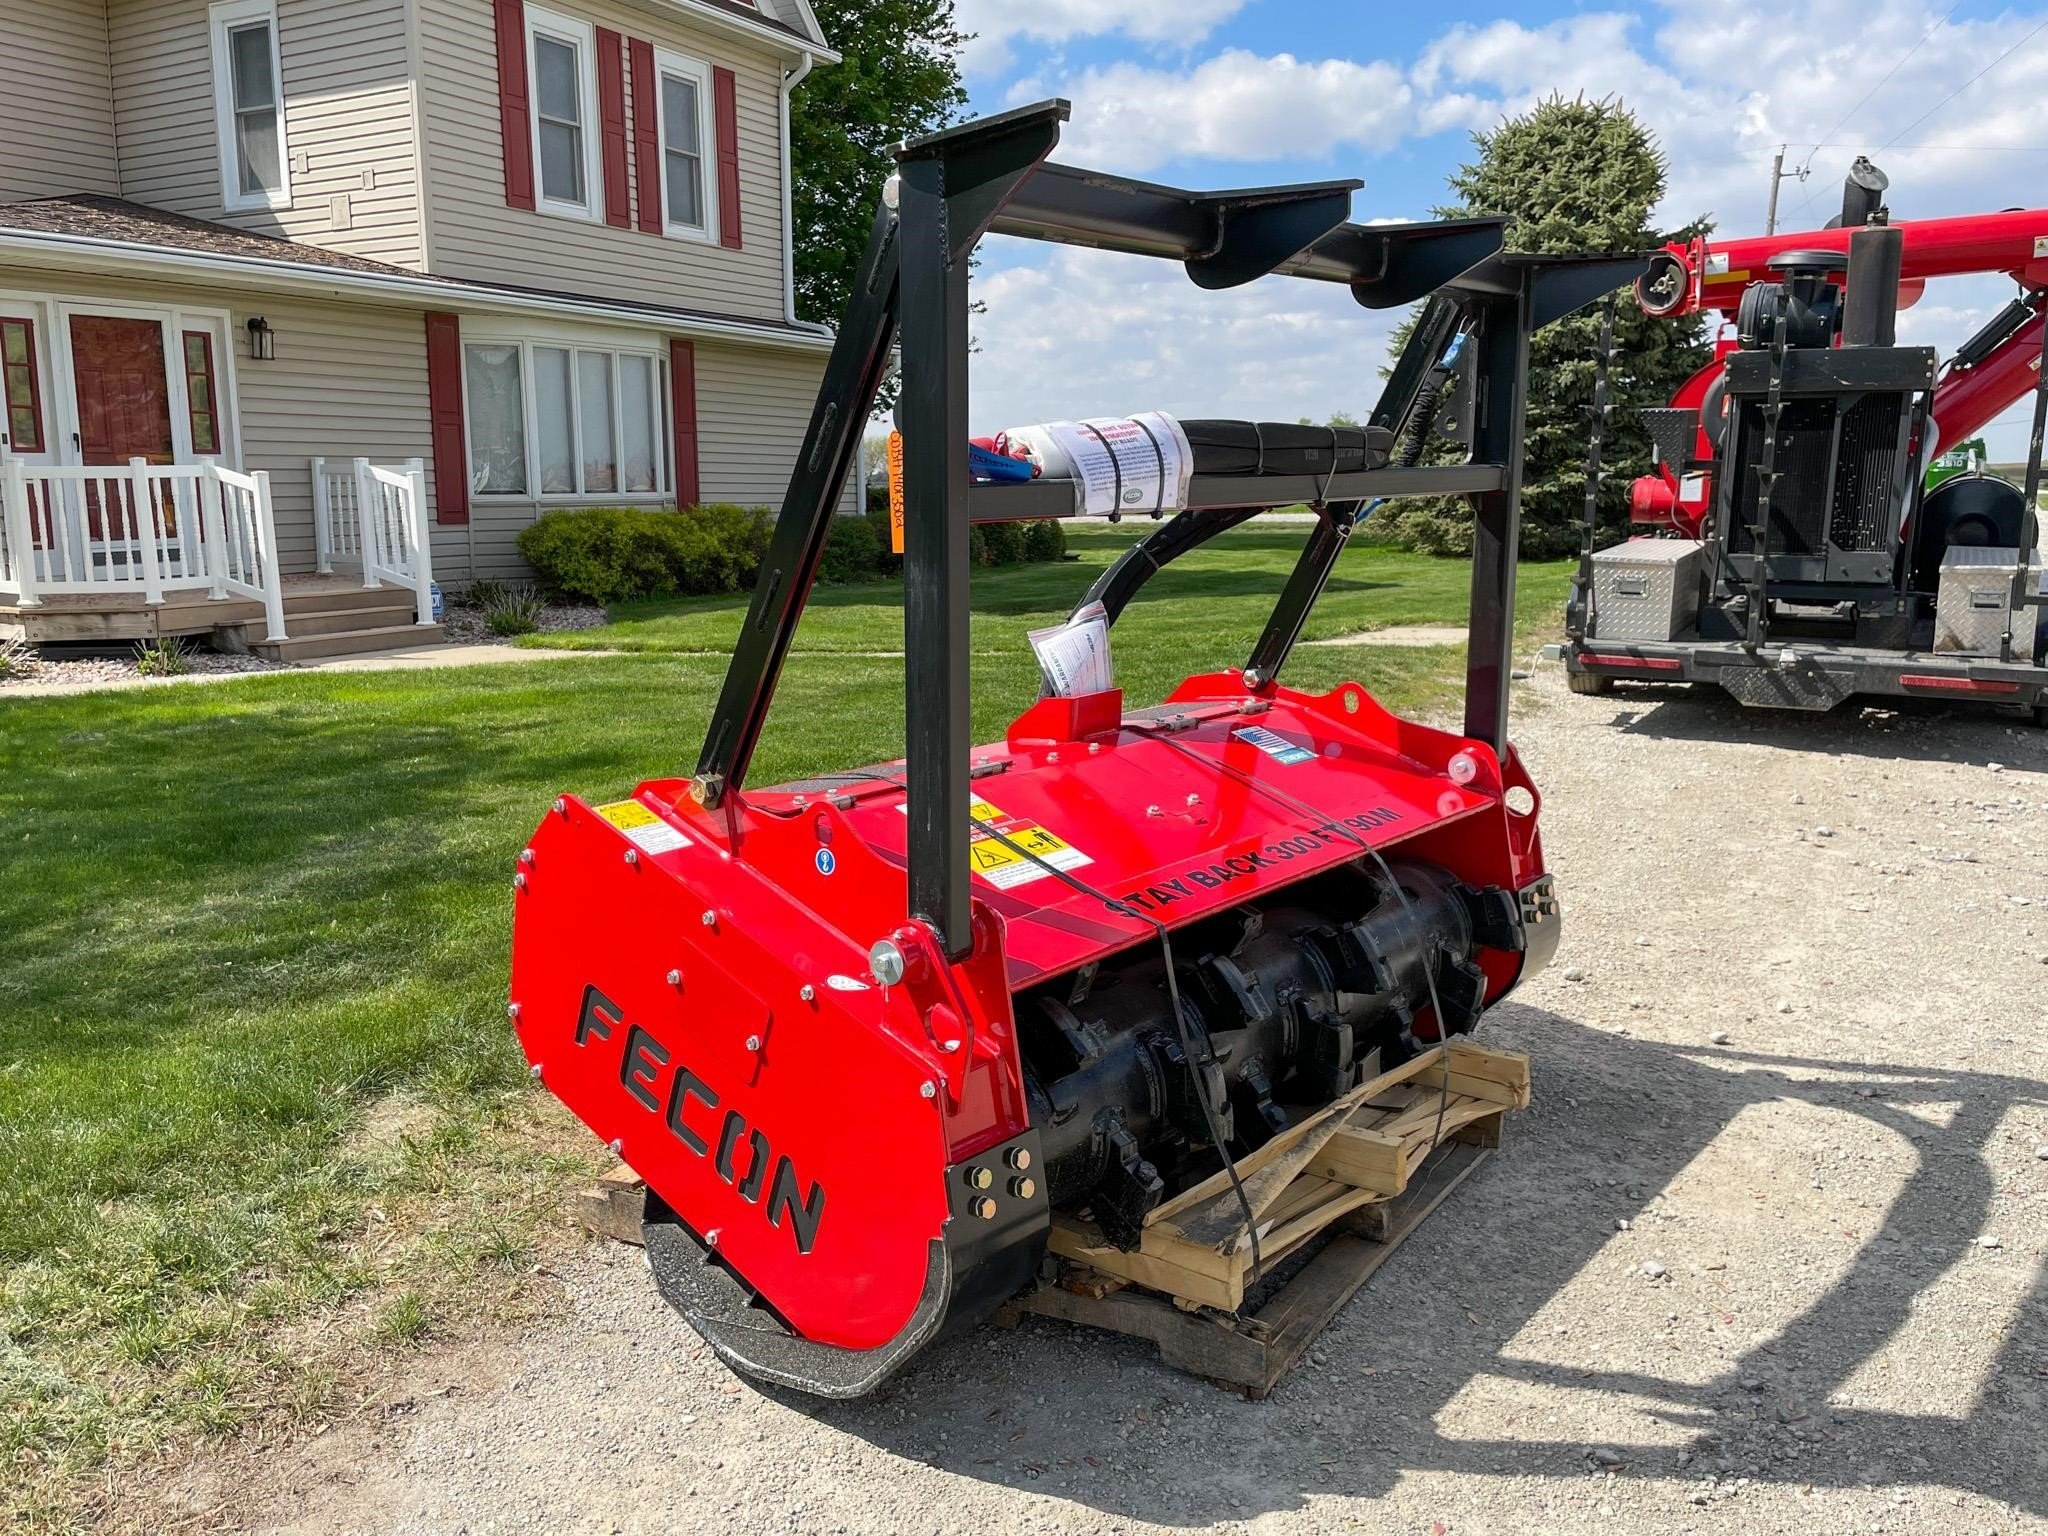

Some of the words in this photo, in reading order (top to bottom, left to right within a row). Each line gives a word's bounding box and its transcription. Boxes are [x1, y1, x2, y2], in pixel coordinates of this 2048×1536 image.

[1104, 878, 1194, 917] STAY
[1185, 850, 1279, 889] BACK
[1264, 835, 1322, 860] 300
[1307, 823, 1356, 844] FT
[574, 975, 826, 1255] FECON
